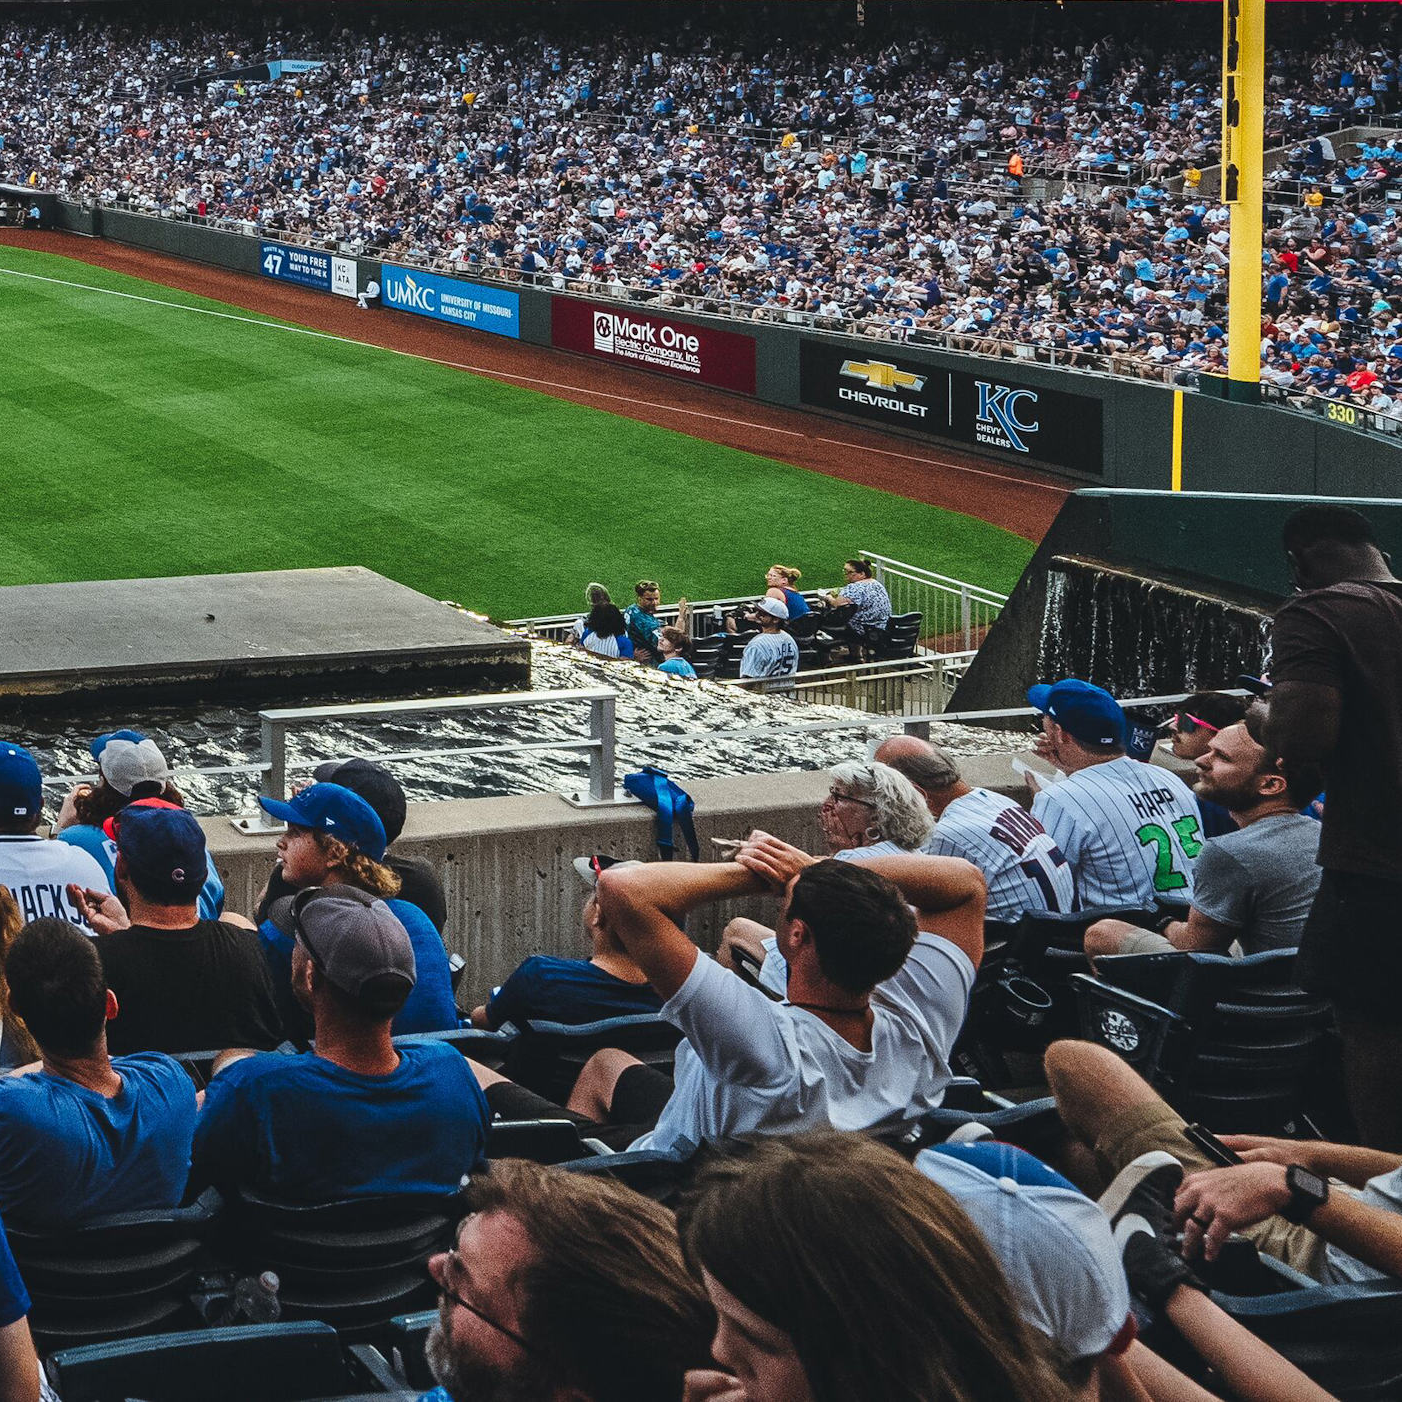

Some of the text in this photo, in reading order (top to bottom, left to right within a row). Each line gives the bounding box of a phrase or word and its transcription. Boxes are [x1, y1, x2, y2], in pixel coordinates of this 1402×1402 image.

[263, 254, 283, 275] 47
[288, 251, 328, 269] YOUR FREE
[289, 262, 328, 279] WAY TO THE K
[337, 274, 350, 284] ATA
[386, 276, 435, 312] UMKC
[440, 293, 473, 310] UNIVERSITY
[473, 301, 481, 311] OF
[440, 305, 477, 322] KANSAS CITY
[614, 315, 700, 353] Mark One
[615, 336, 701, 364] Electric Company, Inc.
[615, 347, 624, 356] The
[624, 350, 638, 359] Mark
[645, 354, 670, 367] Electrical
[670, 359, 701, 374] Excellence
[838, 387, 929, 418] CHEVROLET
[1328, 402, 1355, 425] 330
[974, 380, 1039, 453] KC
[975, 422, 1002, 436] CHEVY
[976, 433, 1012, 449] DEALERS
[1127, 787, 1175, 819] HAPP
[1135, 814, 1204, 893] 25
